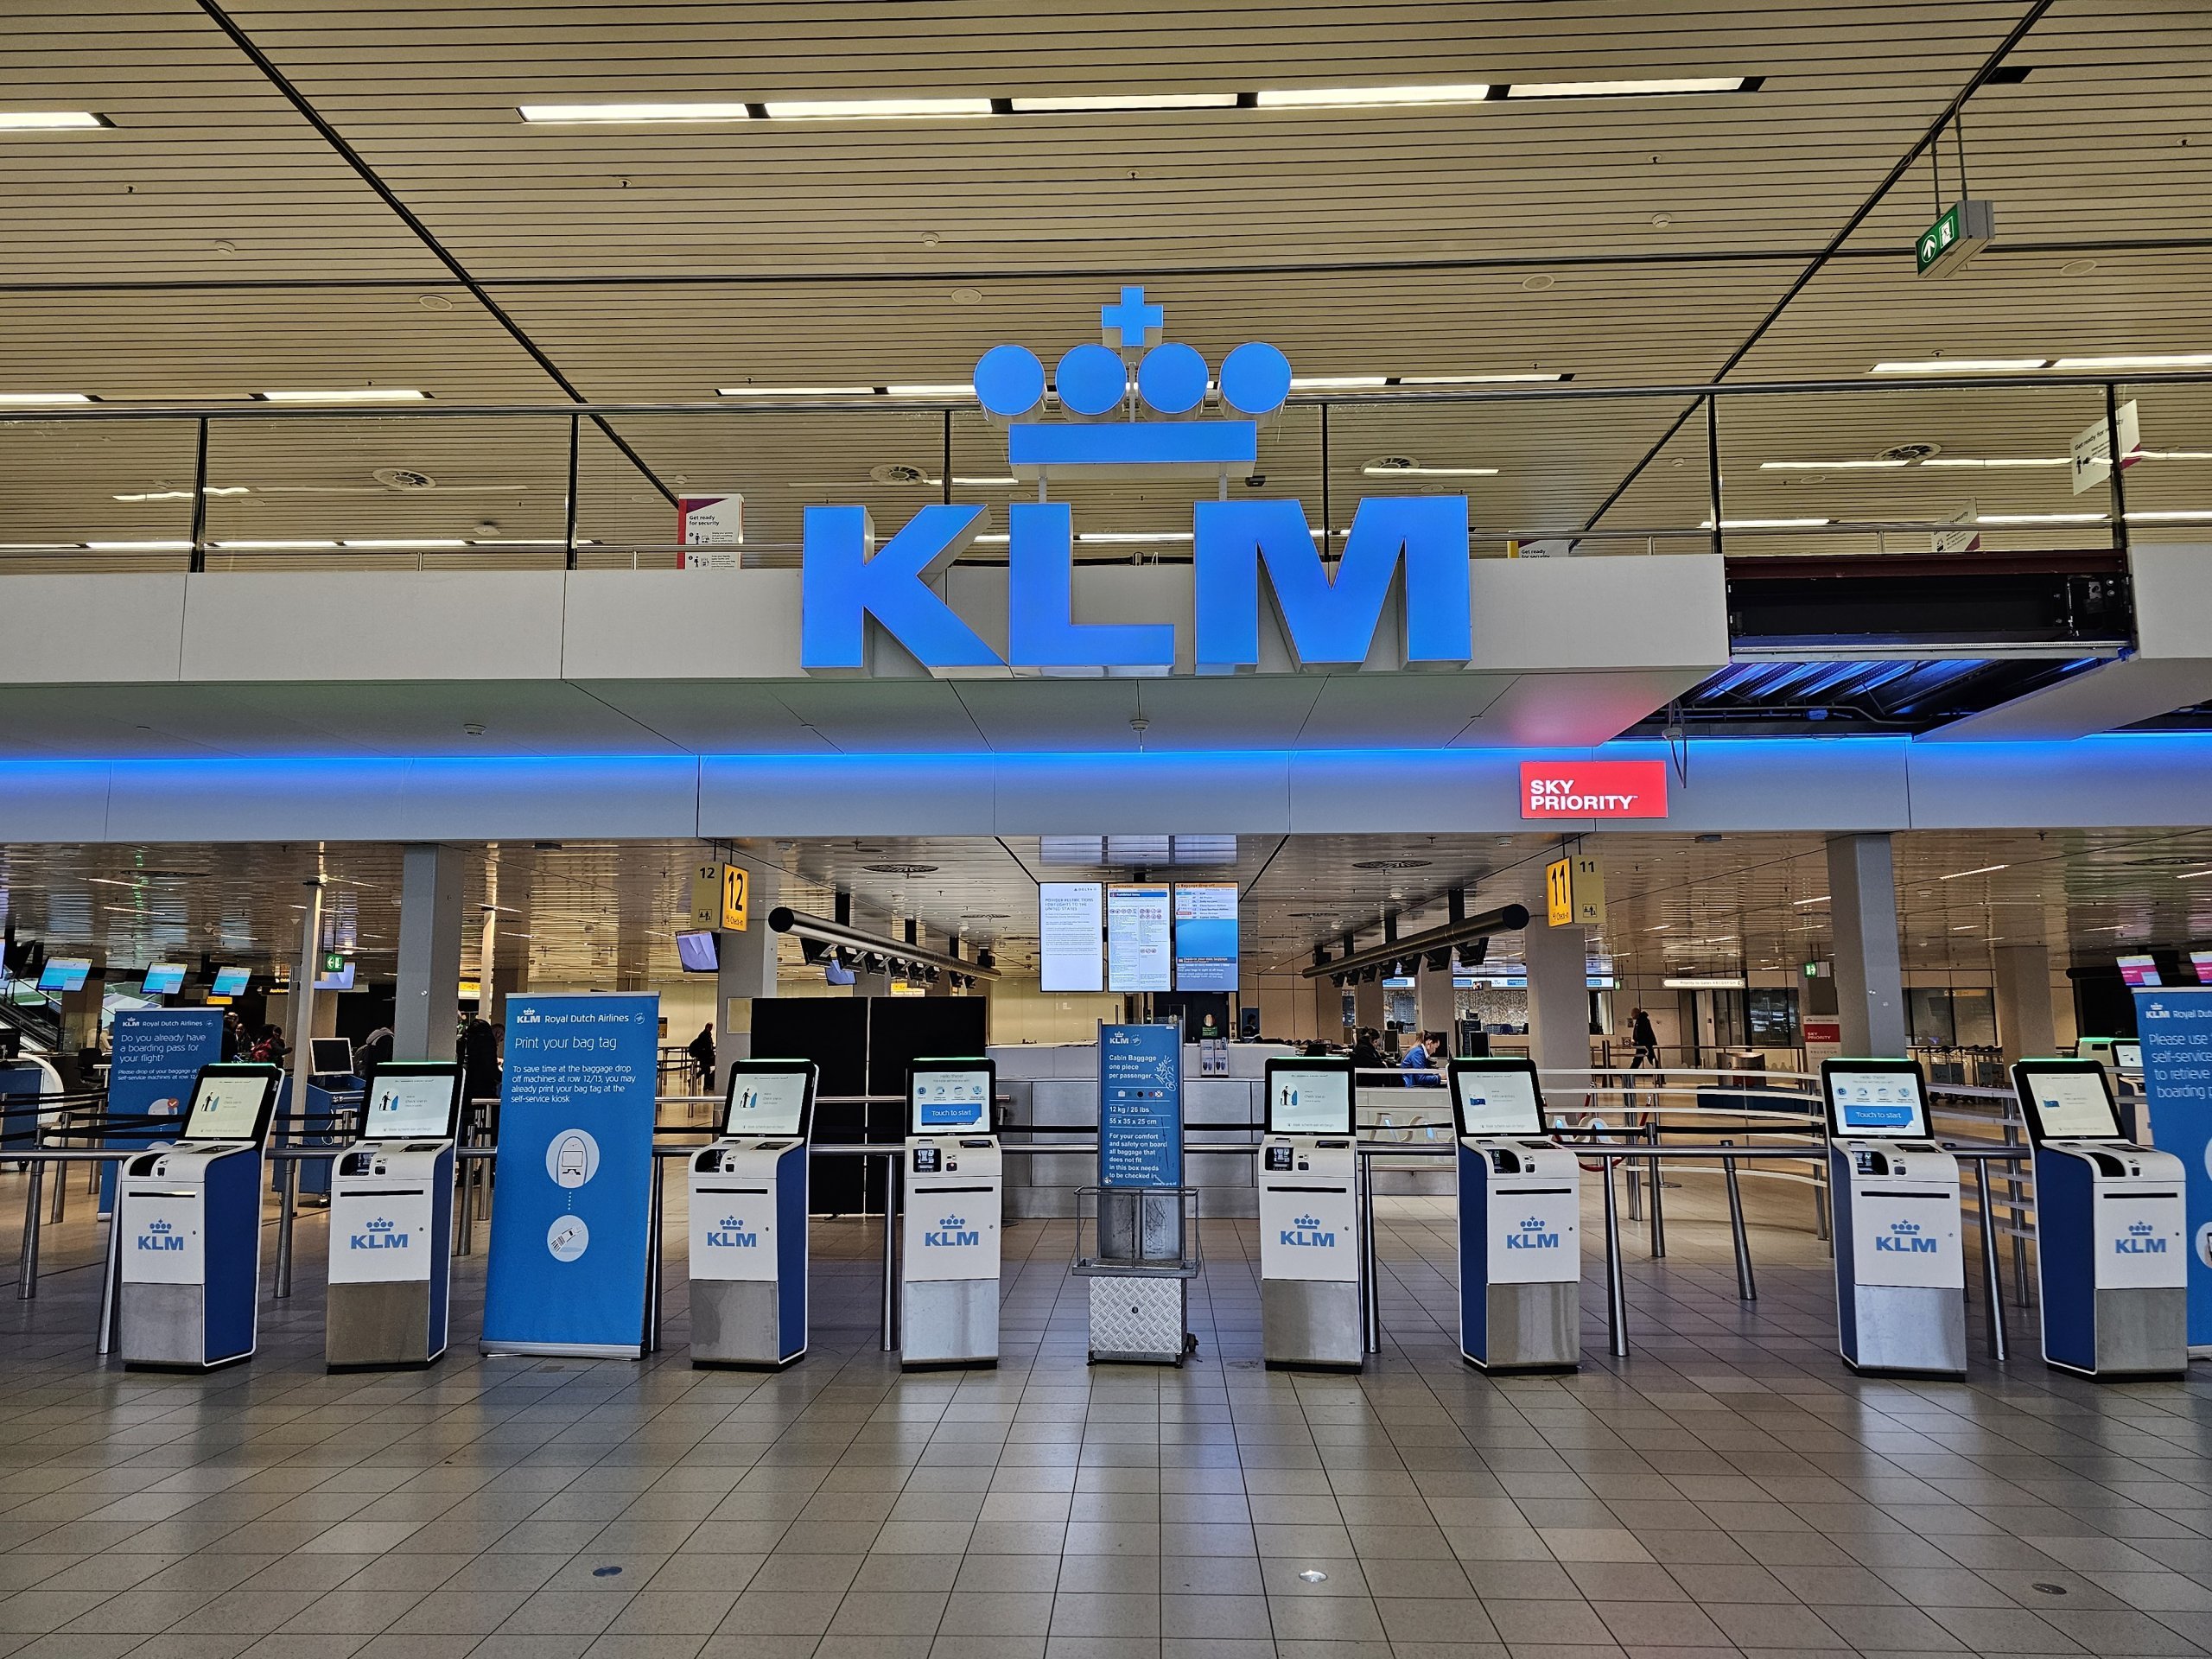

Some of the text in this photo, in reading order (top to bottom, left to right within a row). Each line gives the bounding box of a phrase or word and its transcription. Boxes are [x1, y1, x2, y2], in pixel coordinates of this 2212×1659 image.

[801, 496, 1472, 672] KLM
[1530, 779, 1575, 795] SKY
[700, 867, 715, 878] 12
[1580, 861, 1594, 872] 11
[728, 871, 743, 911] 12
[1552, 864, 1566, 906] 11
[516, 1014, 629, 1024] KLM Royal Dutch Airlines
[2173, 1010, 2196, 1020] Royal
[121, 1033, 207, 1044] Do you already have
[515, 1036, 617, 1051] Print your bag tag
[2148, 1034, 2208, 1046] Please use
[128, 1044, 164, 1053] boarding
[166, 1045, 185, 1053] pass
[119, 1054, 164, 1064] your flight?
[1128, 1055, 1157, 1063] Baggage
[582, 1065, 613, 1074] baggage
[615, 1065, 631, 1074] drop
[2154, 1067, 2211, 1080] to retrieve
[583, 1074, 604, 1084] 12/13,
[605, 1076, 619, 1084] you
[620, 1075, 636, 1084] may
[511, 1085, 537, 1094] already
[539, 1084, 554, 1094] print
[556, 1086, 572, 1094] your
[574, 1085, 587, 1093] bag
[590, 1085, 602, 1093] tag
[2156, 1085, 2205, 1100] boarding
[552, 1094, 570, 1103] kiosk
[137, 1236, 184, 1250] KLM
[351, 1233, 409, 1249] KLM
[707, 1232, 757, 1247] KLM
[925, 1231, 979, 1247] KLM
[1281, 1230, 1335, 1247] KLM
[1507, 1233, 1559, 1249] KLM
[1875, 1236, 1937, 1253] KLM
[2115, 1238, 2167, 1253] KLM
